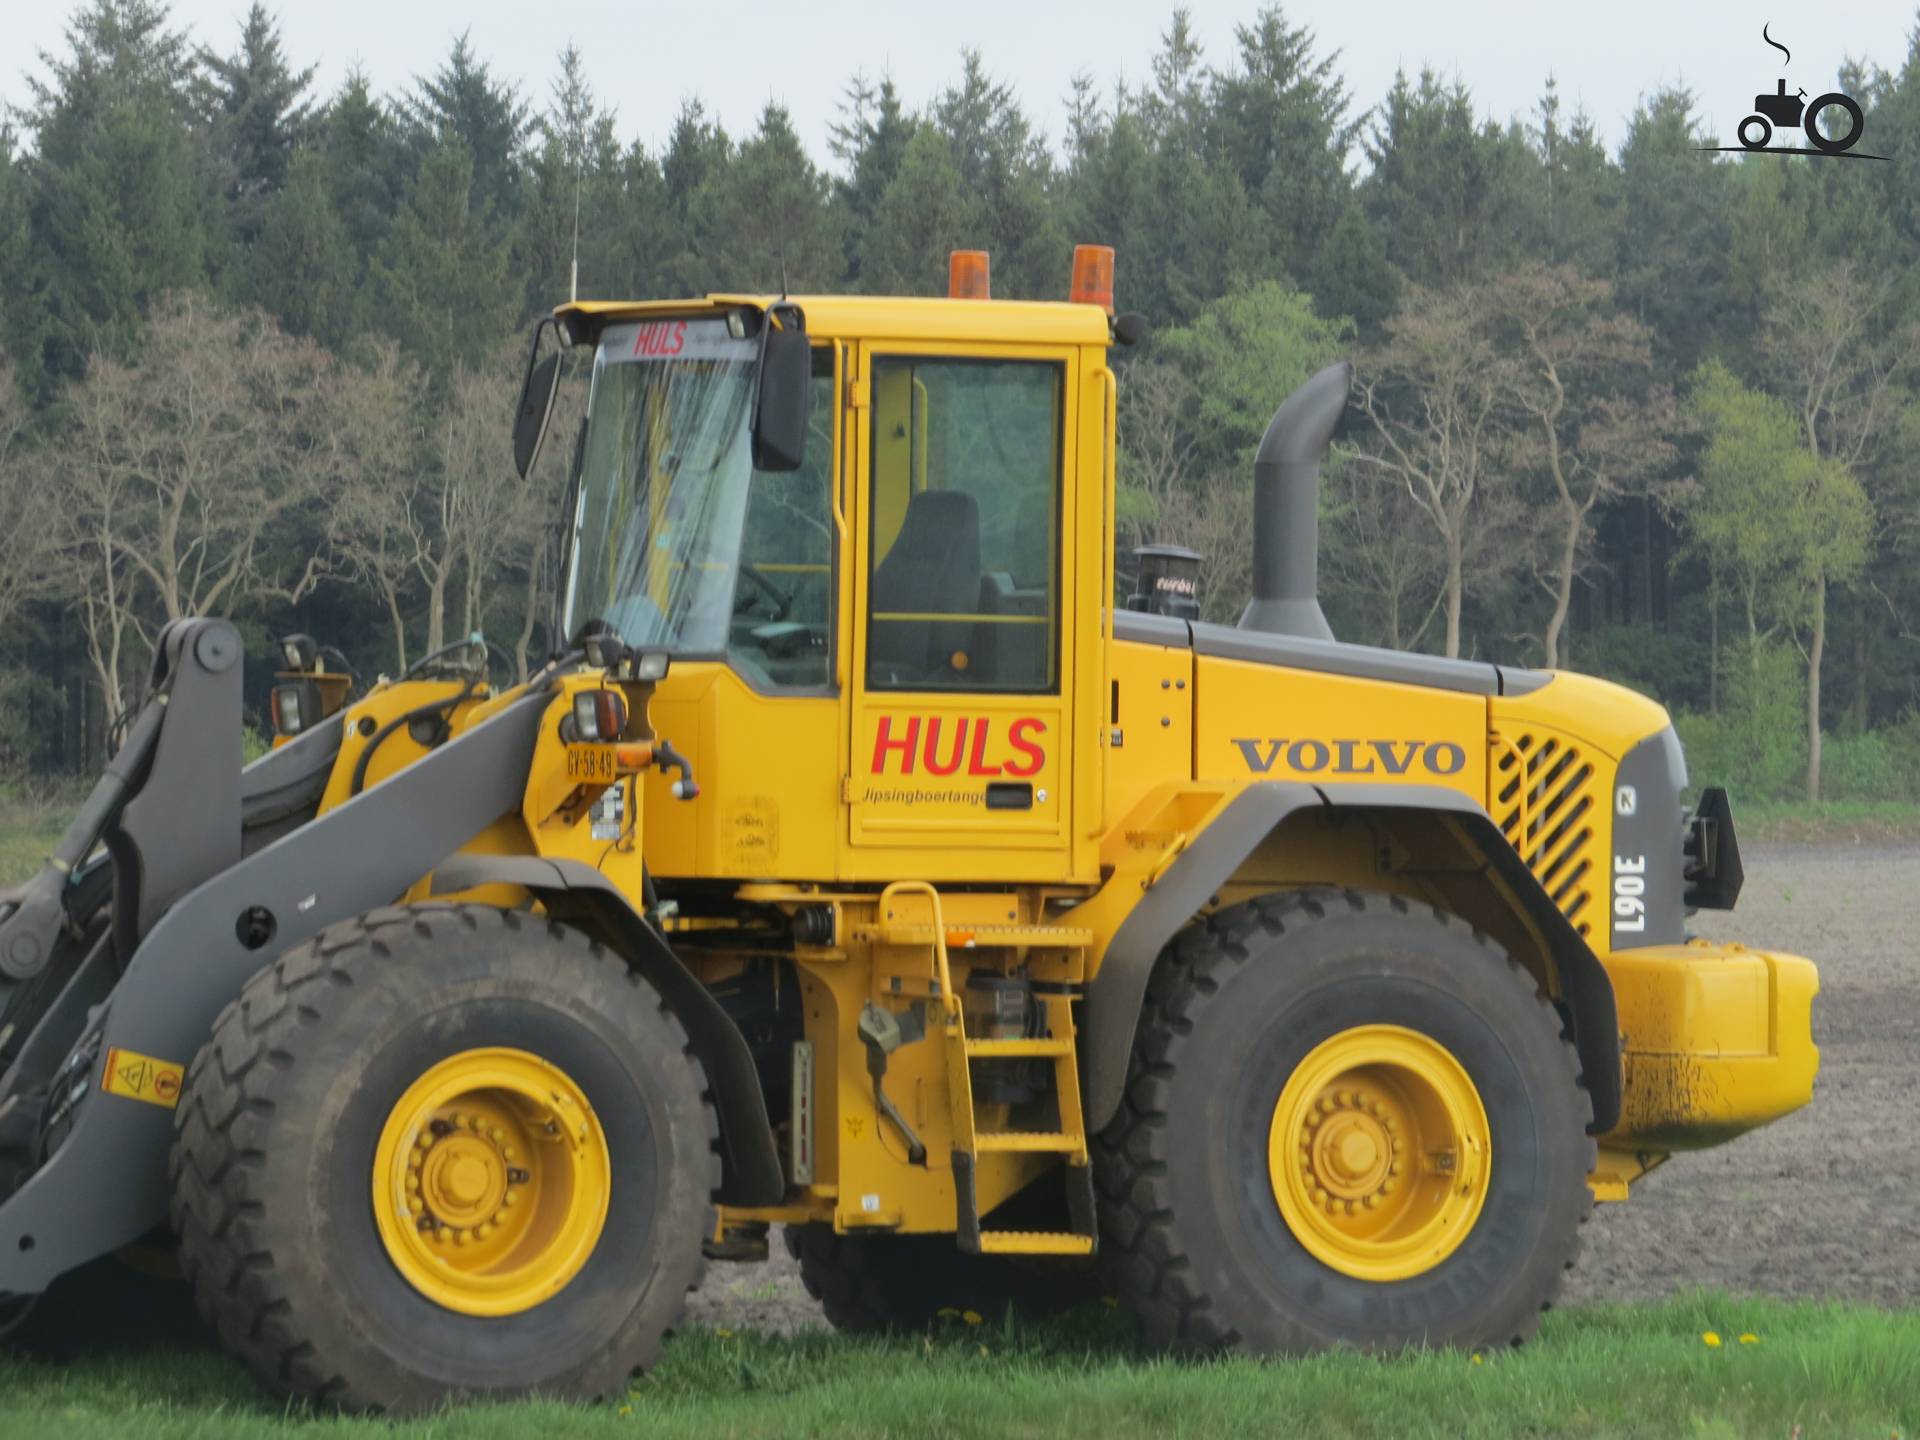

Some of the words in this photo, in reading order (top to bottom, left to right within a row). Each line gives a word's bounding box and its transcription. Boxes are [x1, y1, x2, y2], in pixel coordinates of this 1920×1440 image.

[634, 320, 687, 354] HULS
[871, 716, 1047, 777] HULS
[1230, 738, 1466, 775] VOLVO
[1614, 855, 1645, 932] L90E
